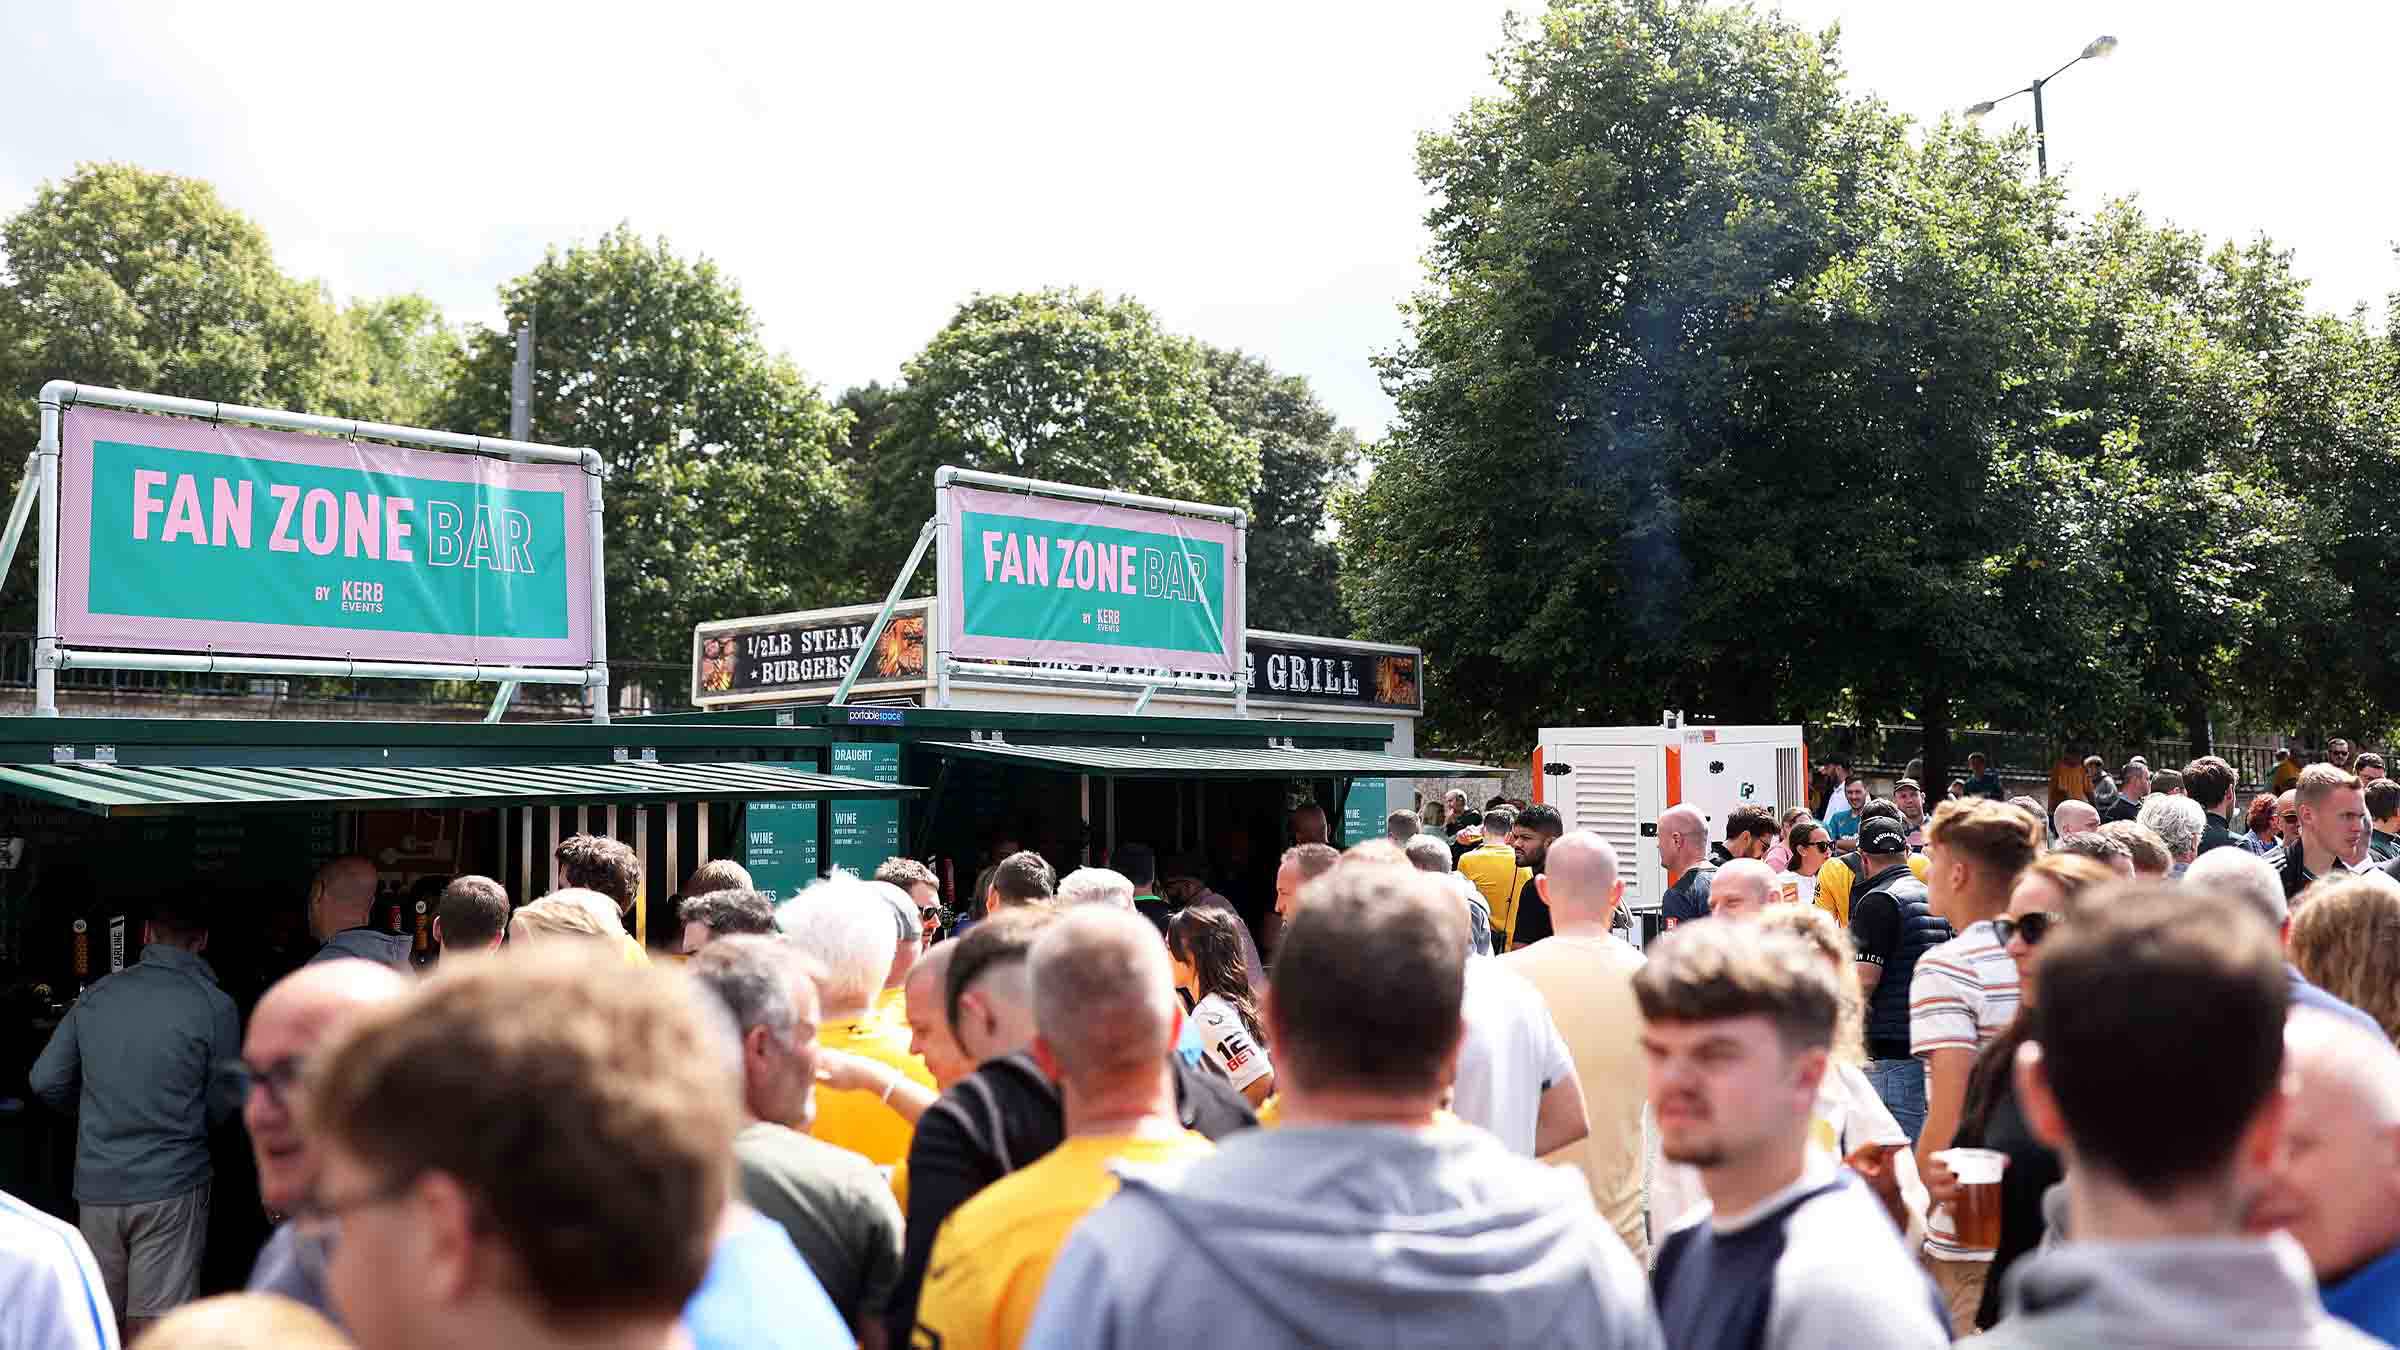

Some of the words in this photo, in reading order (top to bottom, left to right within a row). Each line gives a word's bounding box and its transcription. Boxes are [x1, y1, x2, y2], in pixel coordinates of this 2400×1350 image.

[133, 468, 253, 549] FAN
[269, 485, 414, 563] ZONE
[427, 500, 536, 574] BAR
[982, 530, 1049, 587] FAN
[1056, 538, 1137, 595] ZONE
[1144, 548, 1208, 602] BAR
[315, 586, 331, 601] BY
[342, 580, 384, 602] KERB
[341, 601, 384, 613] EVENTS
[1096, 609, 1120, 623] KERB
[747, 633, 793, 659] 1/2LB
[801, 625, 865, 654] STEAK
[761, 655, 852, 684] BURGERS
[1267, 653, 1359, 695] GRILL
[849, 710, 902, 722] portablespace
[834, 750, 873, 761] DRAUGHT
[835, 812, 857, 824] WINE
[750, 832, 774, 844] WINE
[1217, 1032, 1249, 1061] 12
[1227, 1049, 1255, 1072] BET
